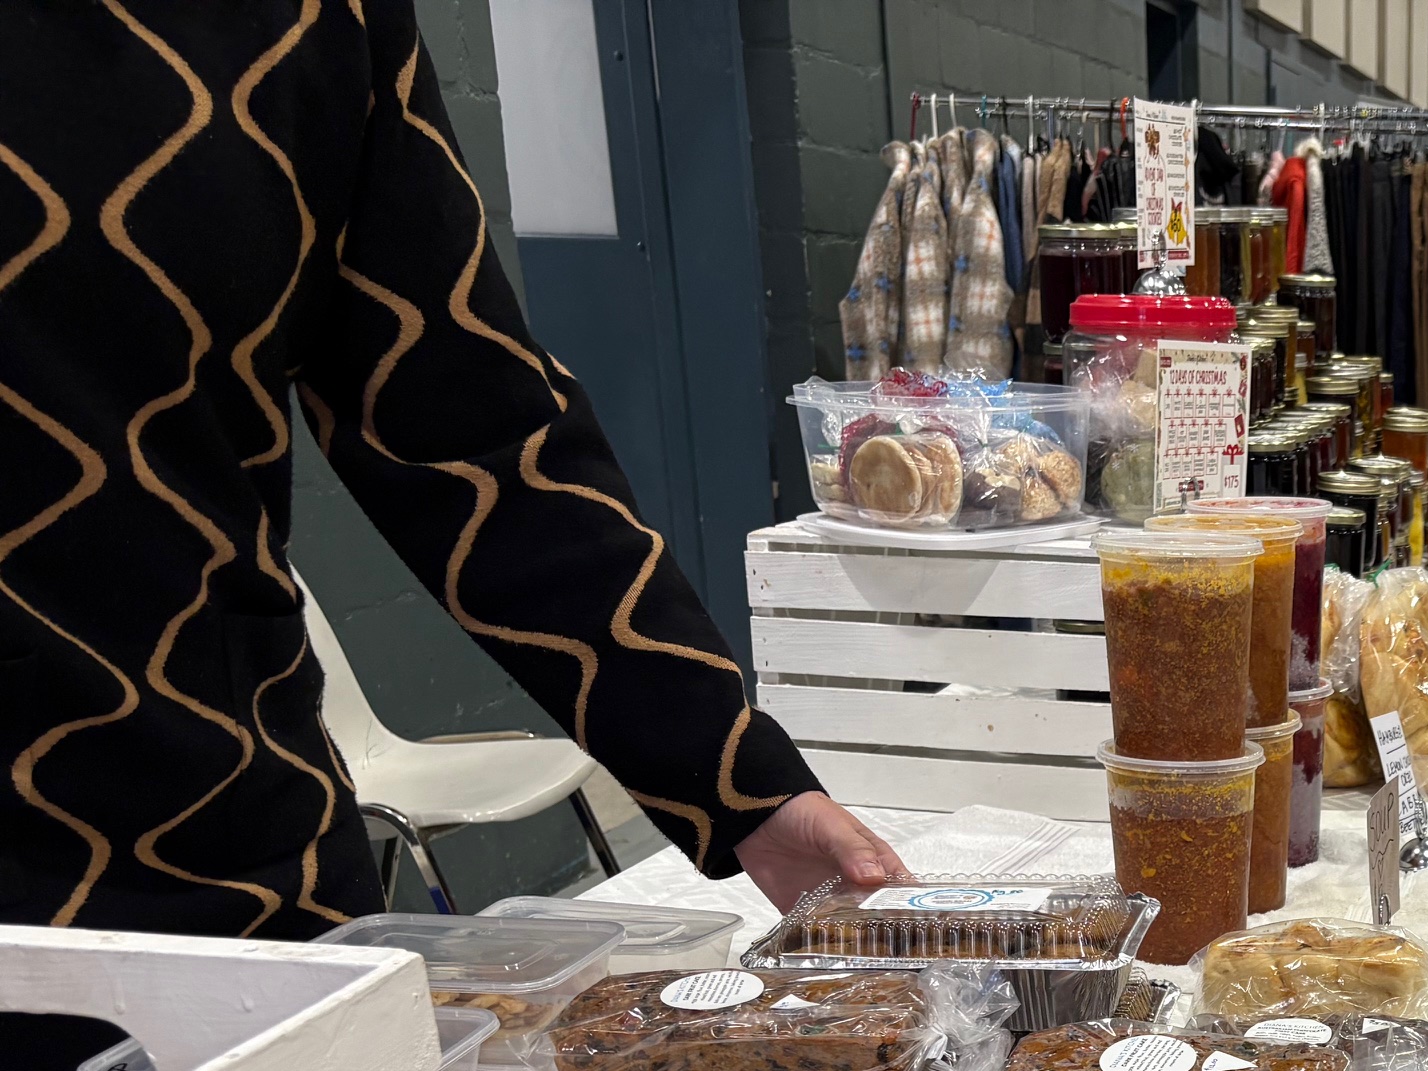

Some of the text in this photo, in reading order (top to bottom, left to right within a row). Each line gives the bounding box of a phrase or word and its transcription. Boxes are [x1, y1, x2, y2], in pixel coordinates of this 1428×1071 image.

[1196, 370, 1227, 385] CHRISTMAS
[1224, 475, 1239, 488] $175
[1369, 792, 1394, 852] SOUP
